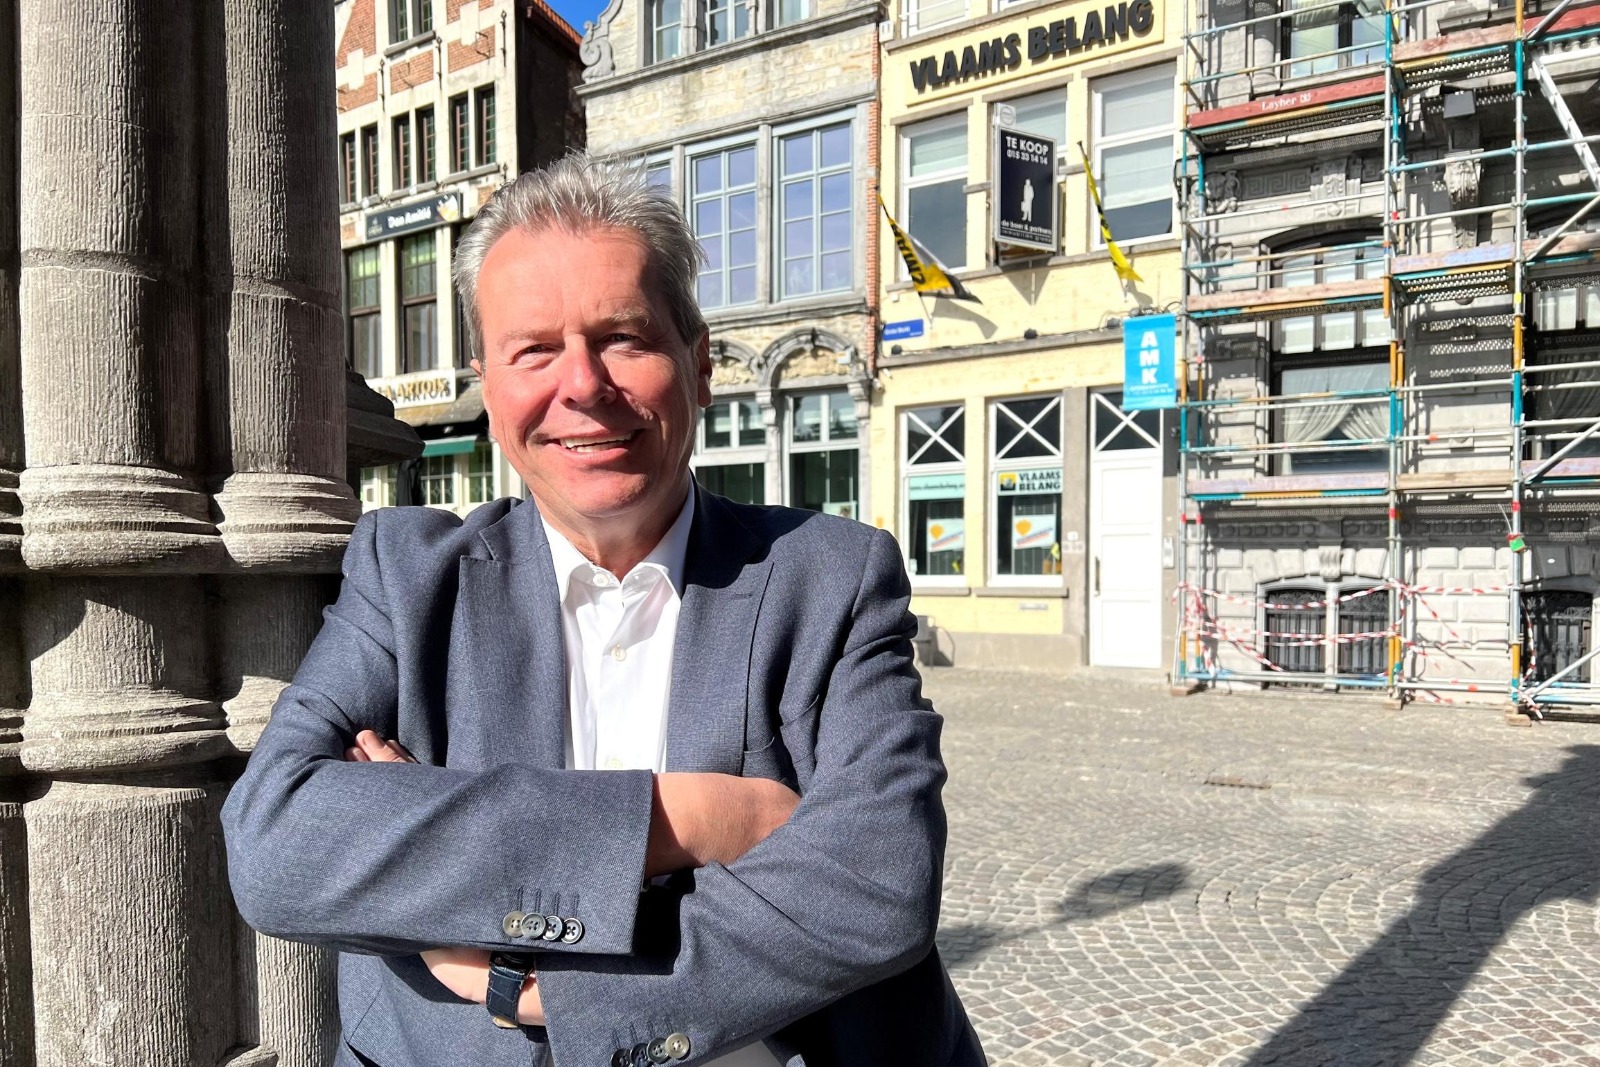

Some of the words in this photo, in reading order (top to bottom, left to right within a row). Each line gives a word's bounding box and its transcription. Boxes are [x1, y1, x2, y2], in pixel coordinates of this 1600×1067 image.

[910, 33, 1021, 92] VLAAMS
[1028, 0, 1154, 61] BELANG
[1262, 97, 1297, 110] Layher
[1006, 136, 1017, 149] TE
[1020, 139, 1049, 155] KOOP
[1007, 149, 1020, 160] 015
[1021, 152, 1030, 161] 33
[397, 380, 446, 397] ARTOIS
[1019, 471, 1061, 480] VLAAMS
[1019, 481, 1061, 490] BELANG
